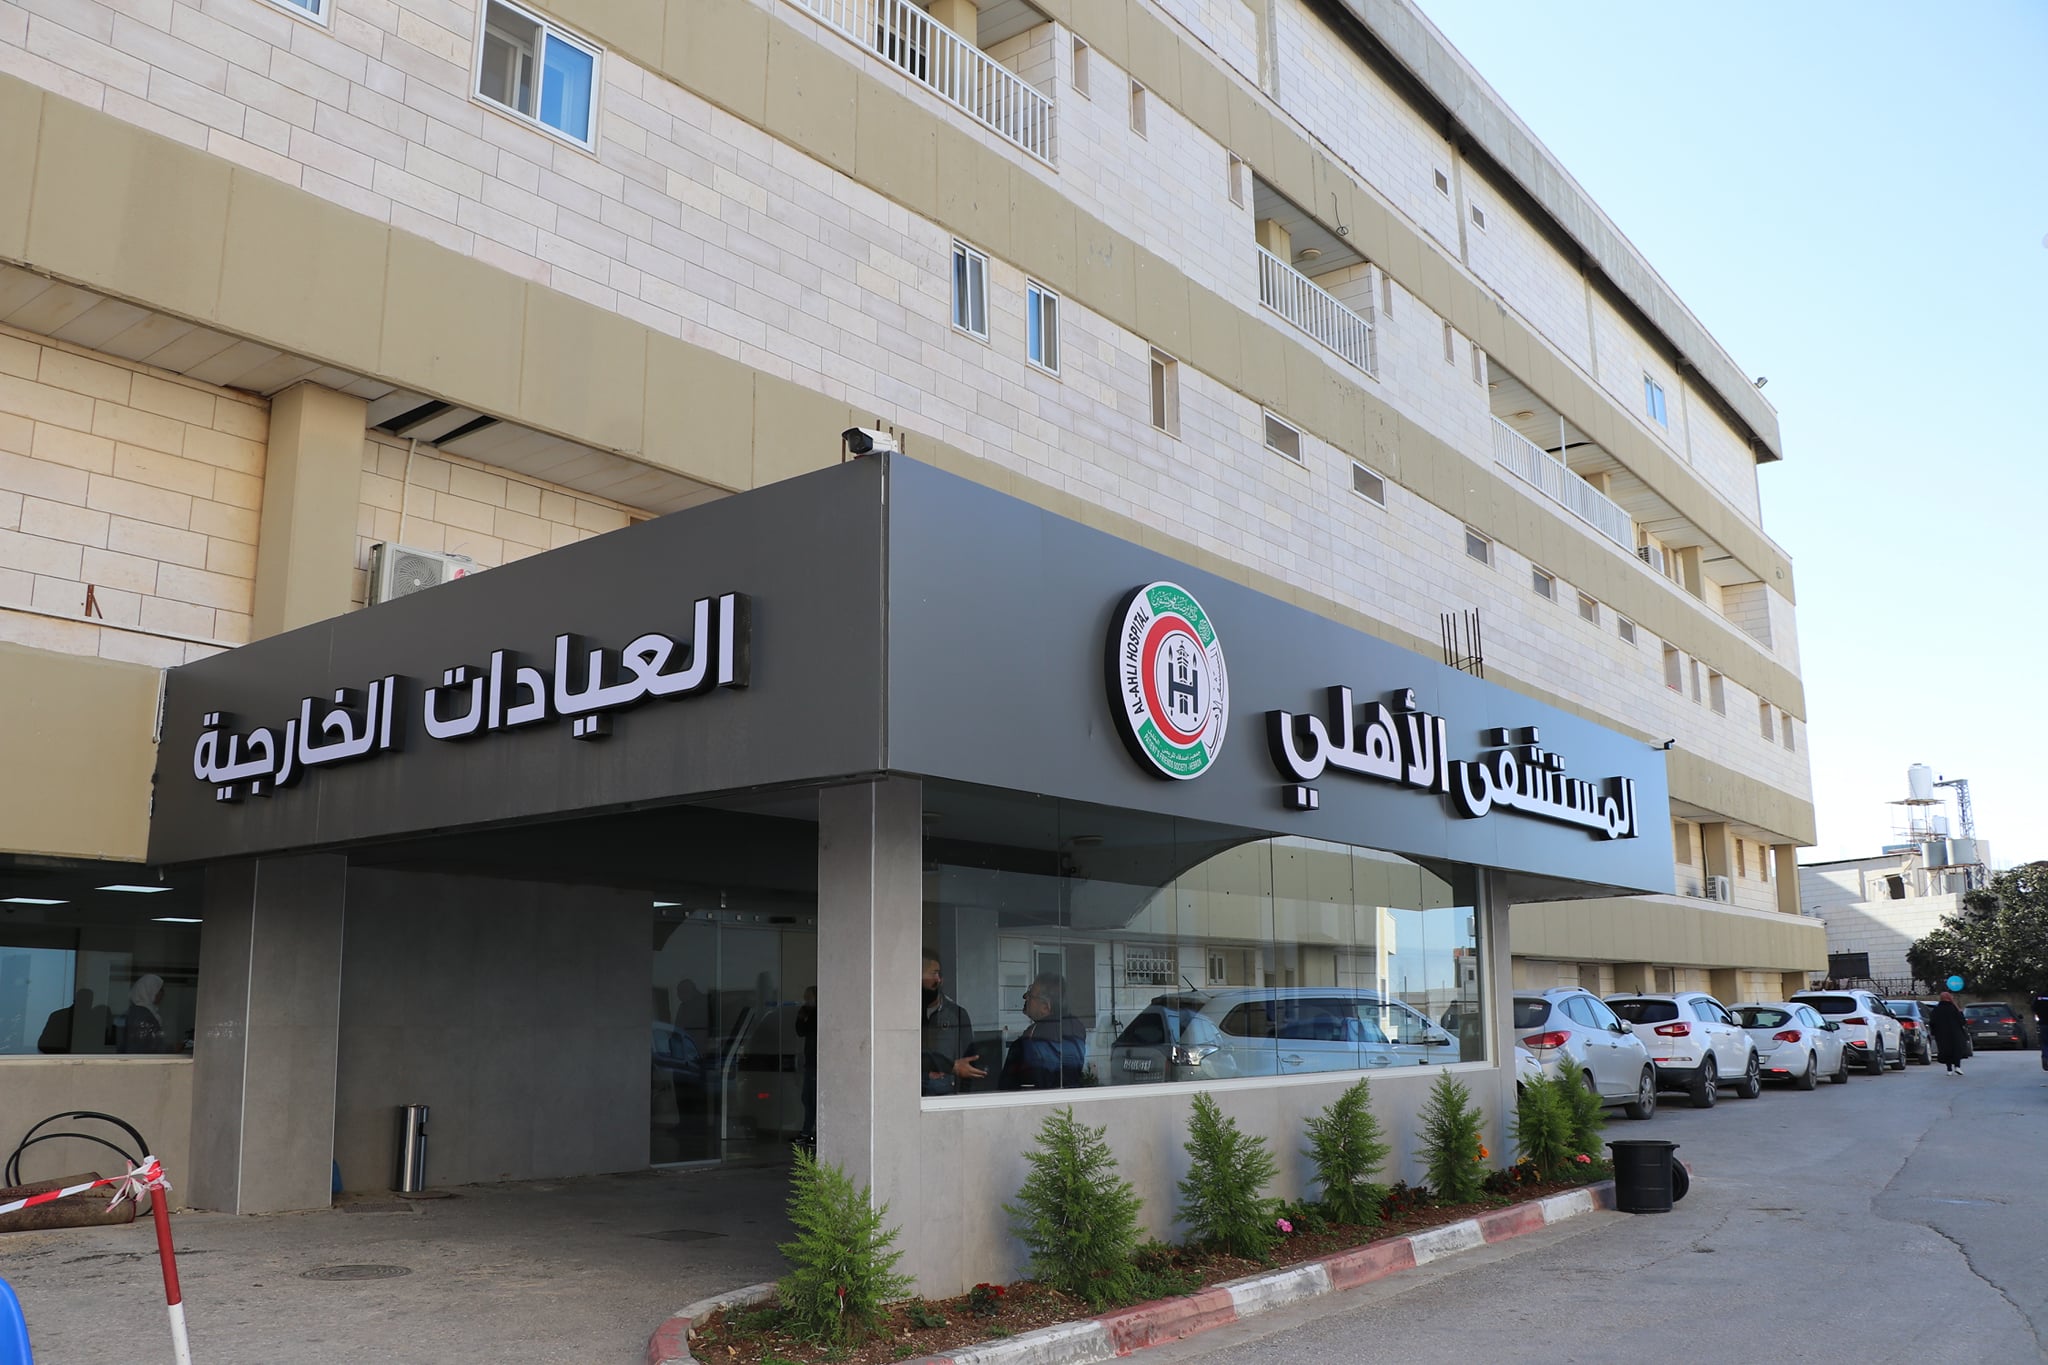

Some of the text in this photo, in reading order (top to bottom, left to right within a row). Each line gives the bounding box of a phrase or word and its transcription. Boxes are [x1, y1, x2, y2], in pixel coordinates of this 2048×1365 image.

[193, 593, 735, 800] العيادات الخارجية
[1126, 606, 1149, 714] AL-AHLI HOSPITAL
[1279, 685, 1639, 839] المستشفى الأهلي
